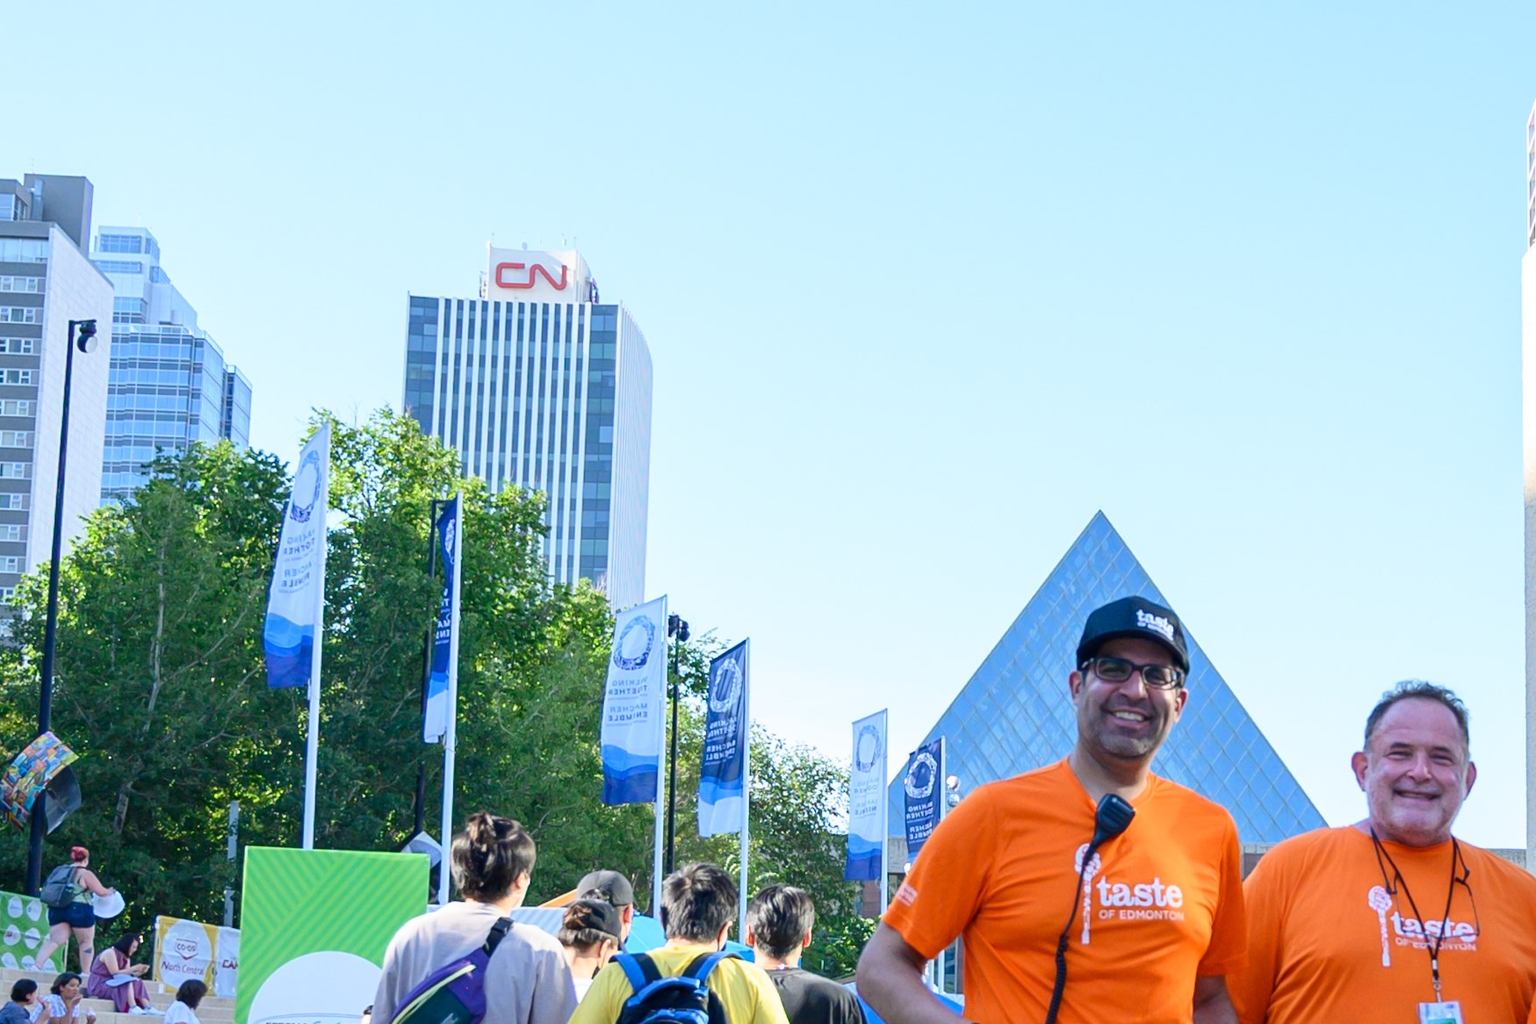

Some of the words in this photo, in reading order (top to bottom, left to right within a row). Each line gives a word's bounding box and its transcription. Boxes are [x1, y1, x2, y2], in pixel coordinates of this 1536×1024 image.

[496, 262, 567, 291] CN
[1096, 875, 1184, 909] taste
[1099, 909, 1116, 920] OF
[1118, 909, 1185, 921] EDMONTON
[1390, 911, 1477, 943] taste
